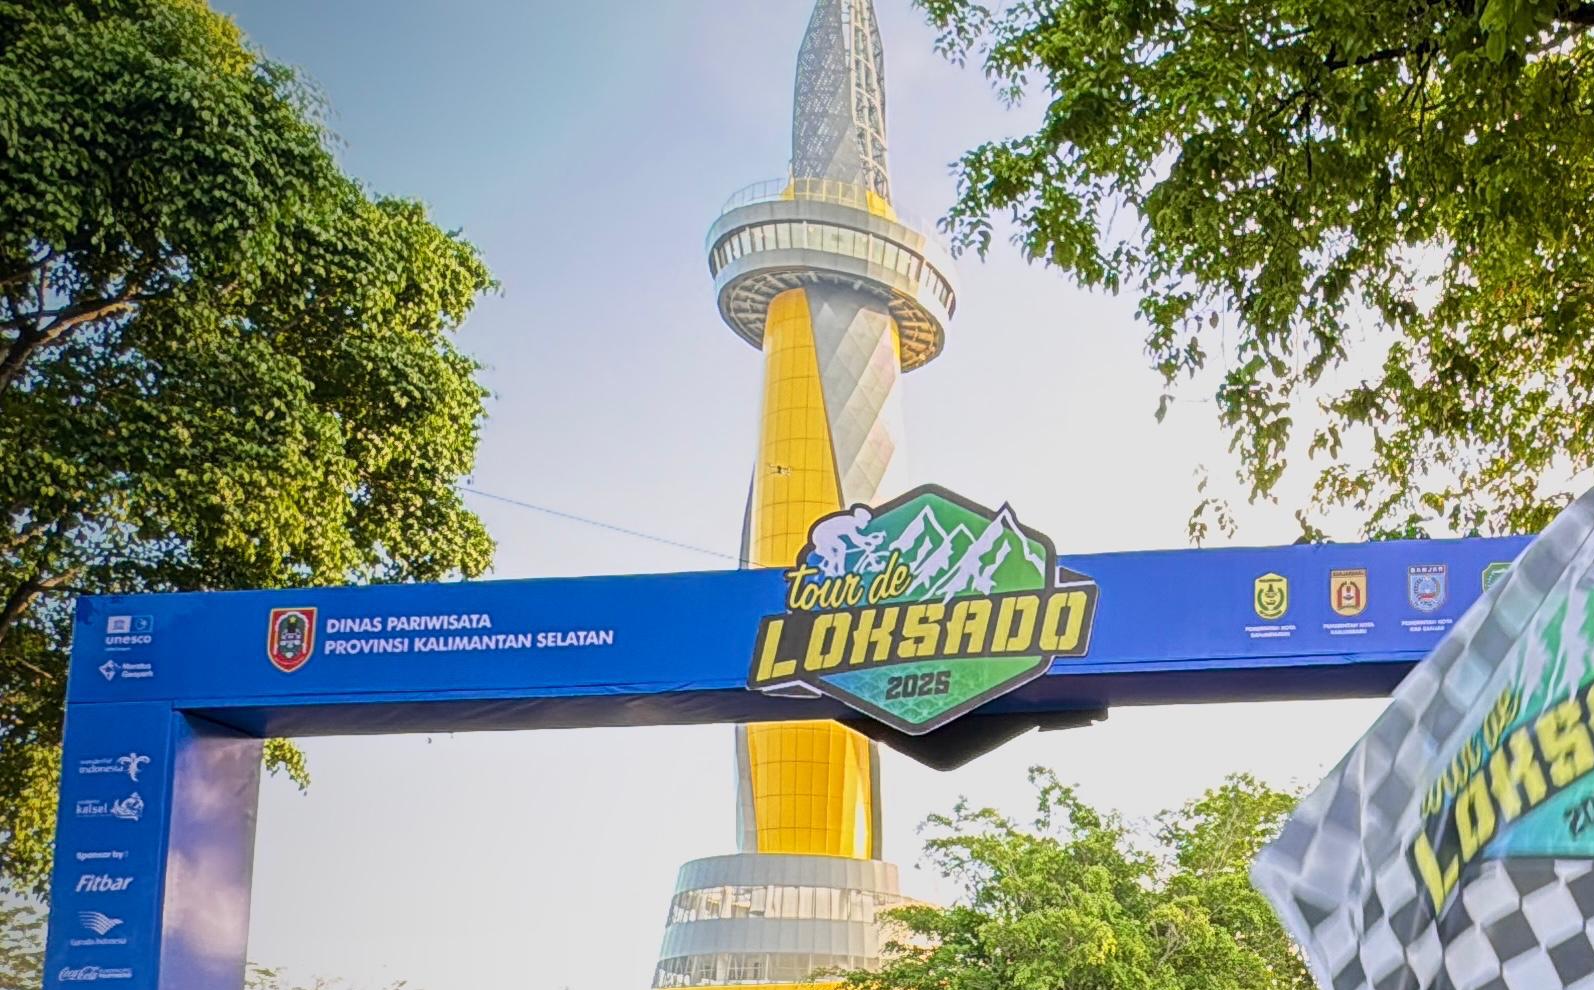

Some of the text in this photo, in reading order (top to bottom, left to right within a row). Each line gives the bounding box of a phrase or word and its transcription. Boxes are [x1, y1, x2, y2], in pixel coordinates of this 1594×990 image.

[868, 551, 912, 605] de
[326, 614, 492, 633] DINAS PARIWISATA
[105, 634, 152, 645] unesco
[324, 630, 614, 655] PROVINSI KALIMANTAN SELATAN
[756, 591, 1088, 682] LOKSADO
[885, 670, 951, 700] 2025
[76, 803, 108, 815] kalsel
[75, 874, 134, 892] Fitbar
